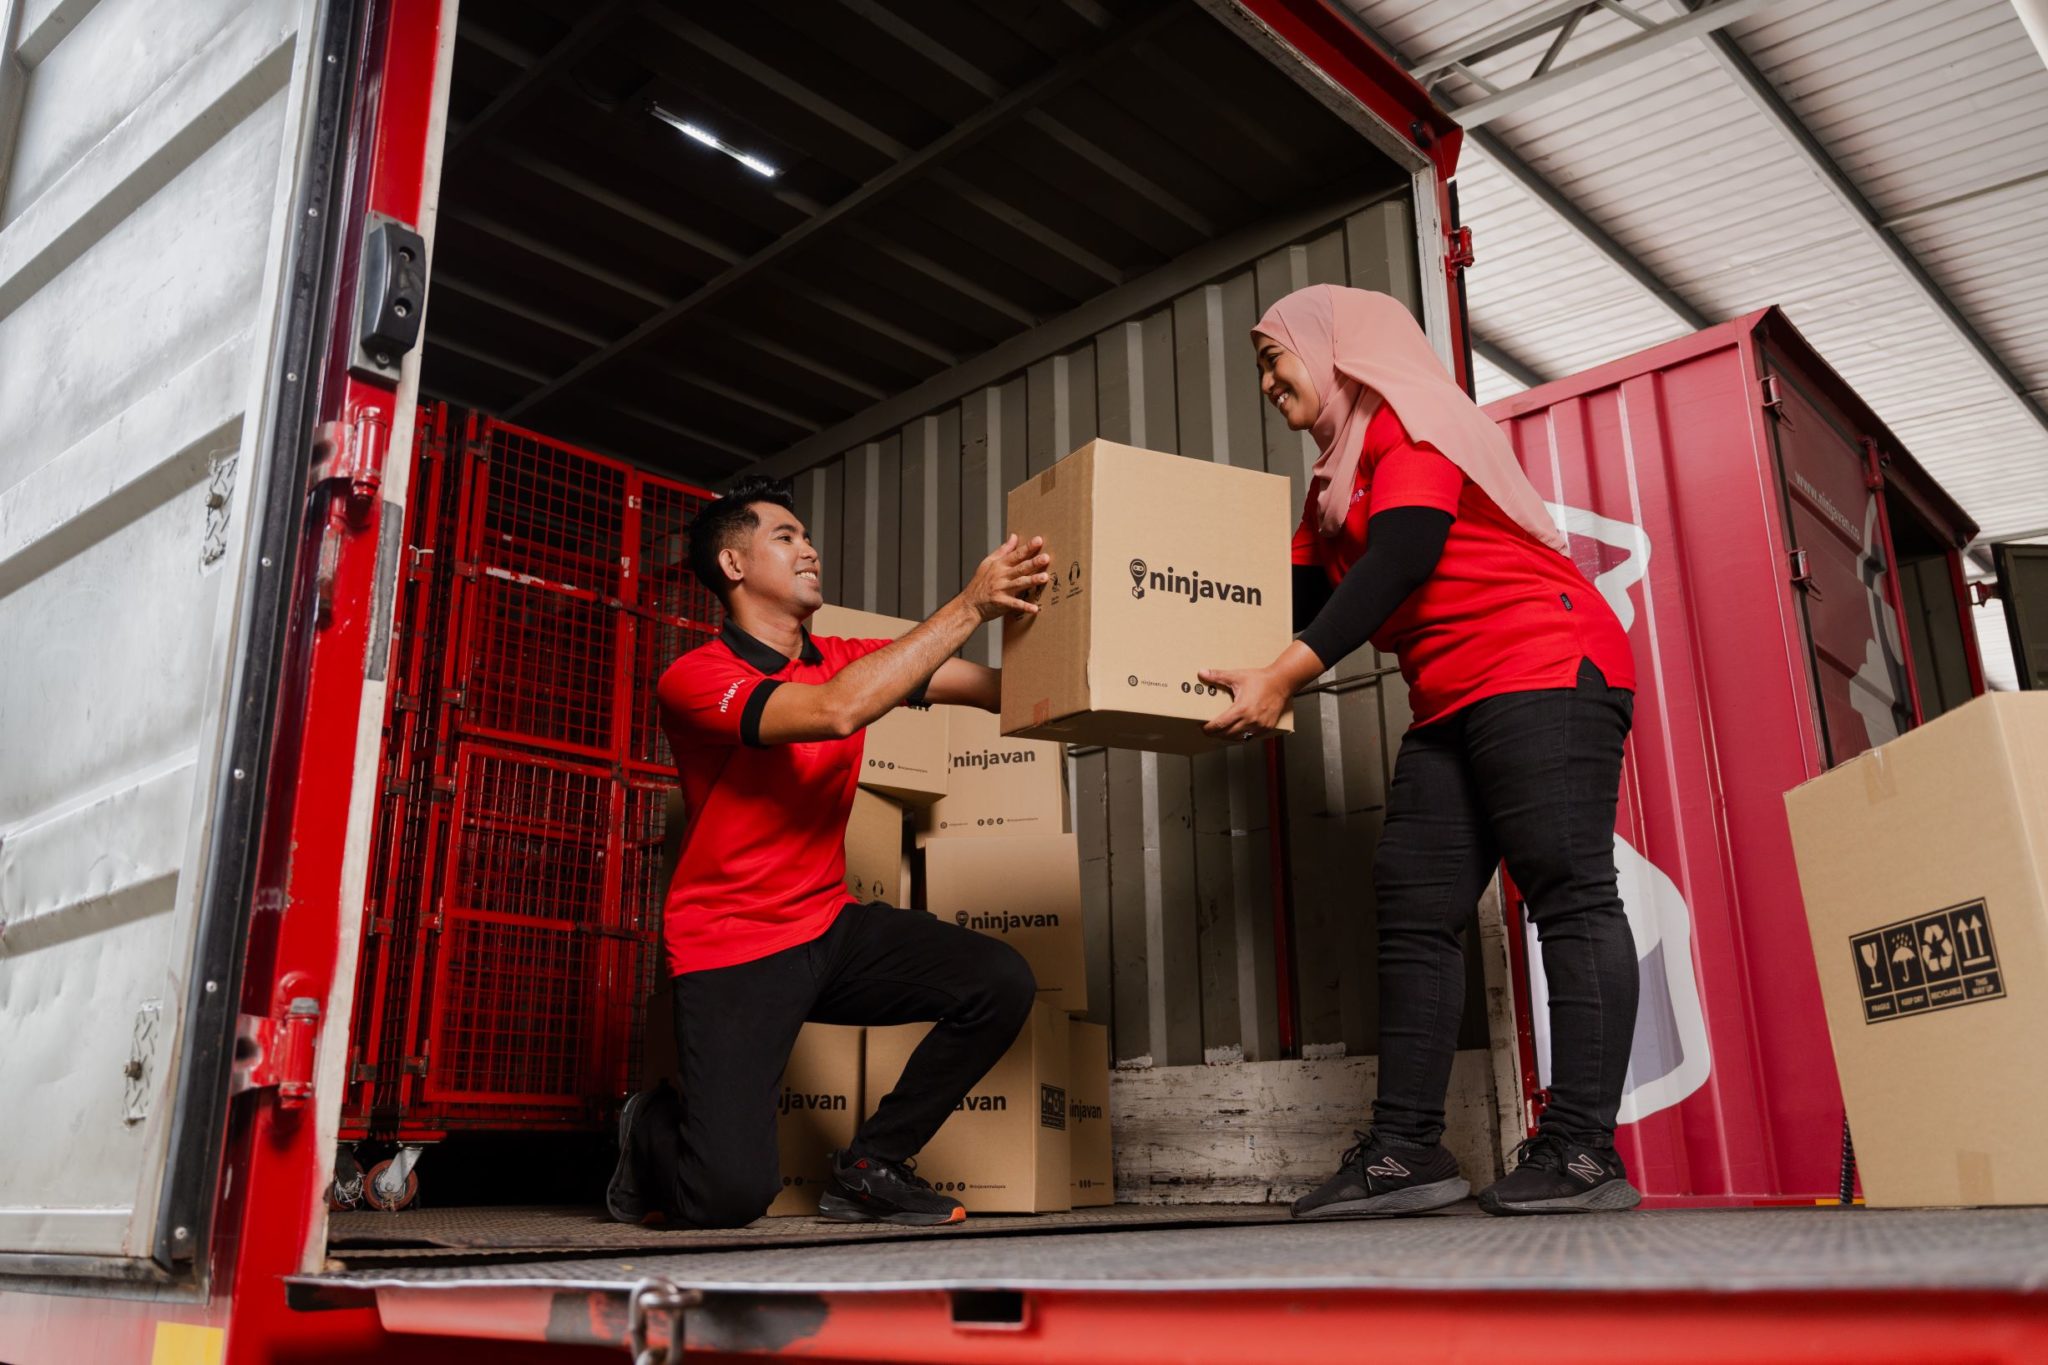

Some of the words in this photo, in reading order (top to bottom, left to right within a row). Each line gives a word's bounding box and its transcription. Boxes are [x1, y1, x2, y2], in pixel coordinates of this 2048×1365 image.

[1150, 566, 1262, 606] ninjavan
[953, 749, 1036, 770] ninjavan
[971, 910, 1059, 934] ninjavan
[1931, 987, 1963, 1000] RECYCLABLE
[778, 1087, 847, 1115] javan
[1068, 1099, 1103, 1122] injavan
